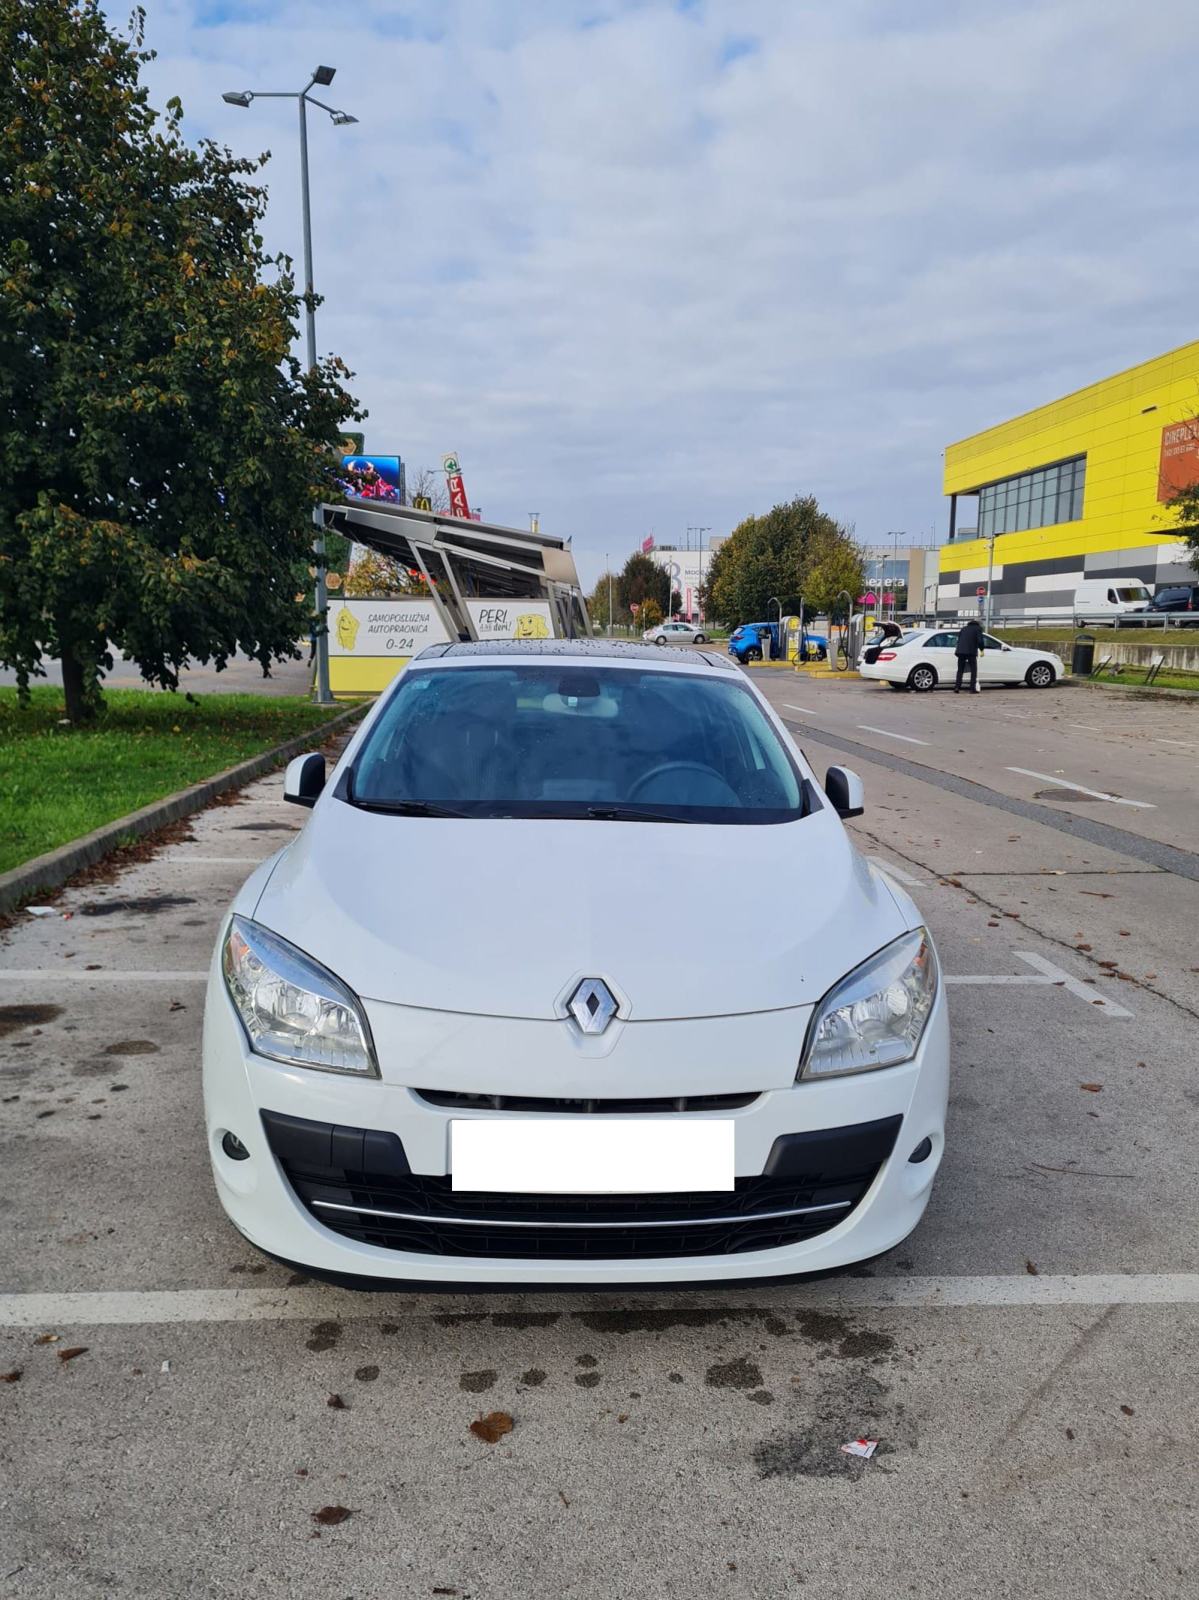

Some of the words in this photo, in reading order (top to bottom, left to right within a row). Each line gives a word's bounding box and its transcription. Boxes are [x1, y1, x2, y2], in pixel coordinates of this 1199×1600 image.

[450, 478, 467, 519] PAR
[479, 609, 508, 623] PERI
[368, 624, 428, 633] AUTOPRAONICA
[385, 638, 414, 649] 0-24
